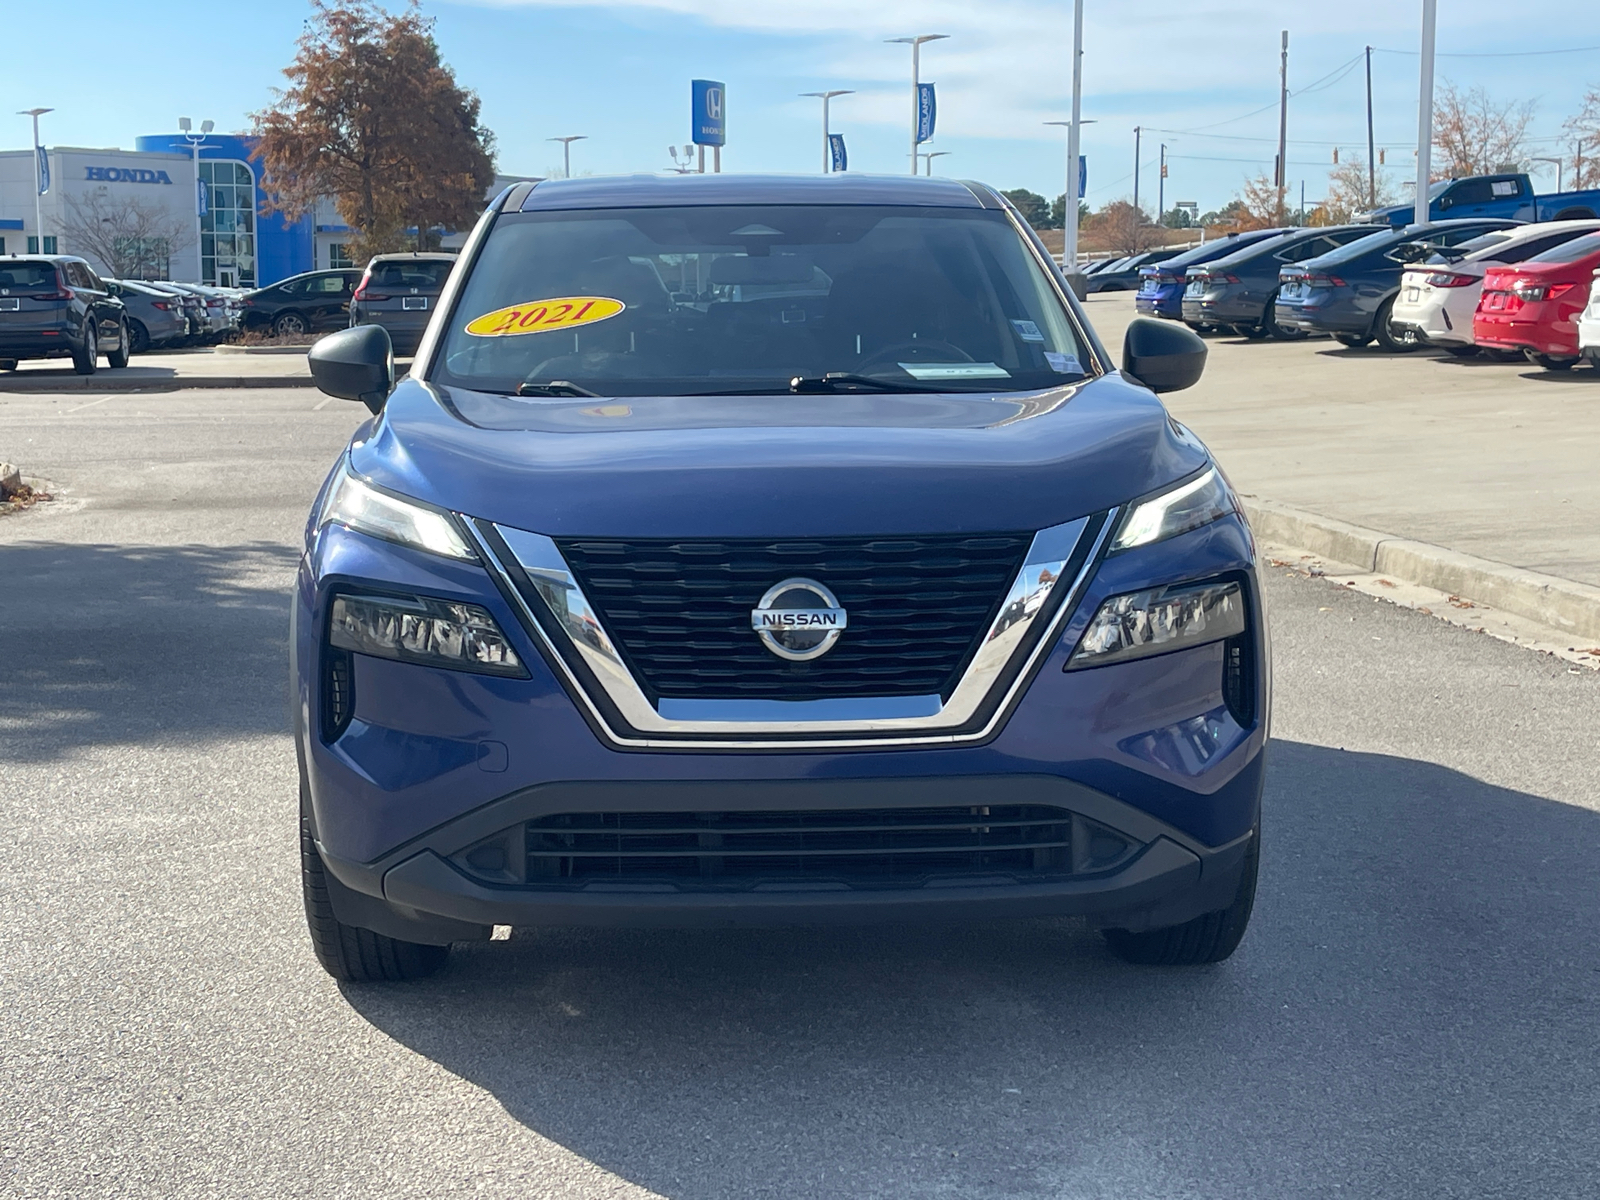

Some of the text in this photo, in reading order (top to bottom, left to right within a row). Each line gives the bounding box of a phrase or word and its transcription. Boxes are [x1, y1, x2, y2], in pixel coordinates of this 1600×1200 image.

[701, 126, 724, 136] HOND
[84, 166, 173, 184] HONDA
[490, 301, 596, 333] 2021
[762, 613, 837, 626] NISSAN
